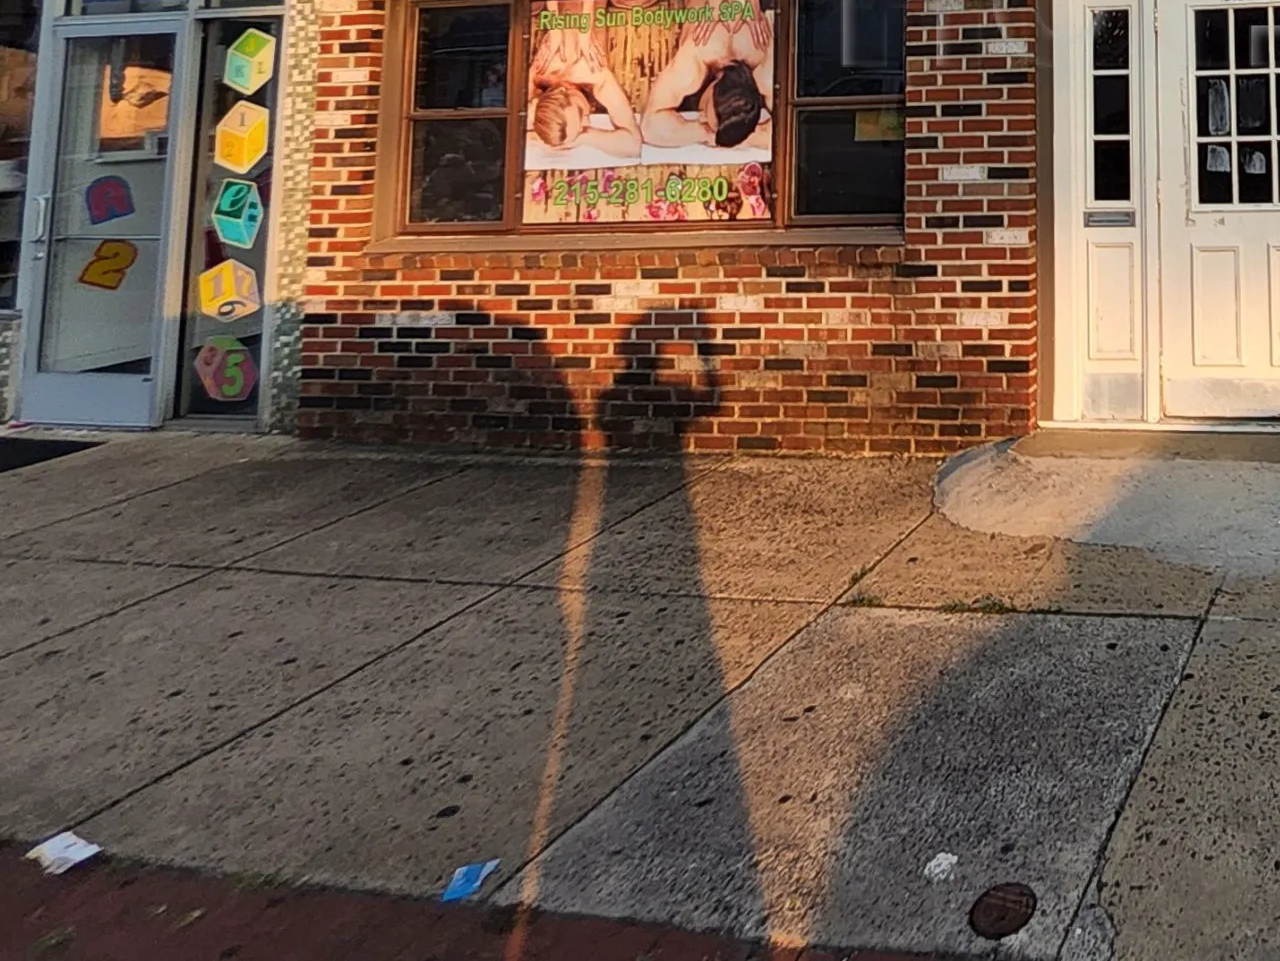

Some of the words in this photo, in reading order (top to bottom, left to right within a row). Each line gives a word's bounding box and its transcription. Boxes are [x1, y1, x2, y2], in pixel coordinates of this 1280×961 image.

[539, 9, 591, 33] Rising
[594, 7, 627, 28] Sun
[631, 3, 714, 28] Bodywork
[718, 0, 756, 22] SPA
[553, 176, 730, 207] 215-281-6280
[78, 239, 139, 289] 2
[221, 352, 245, 397] 5
